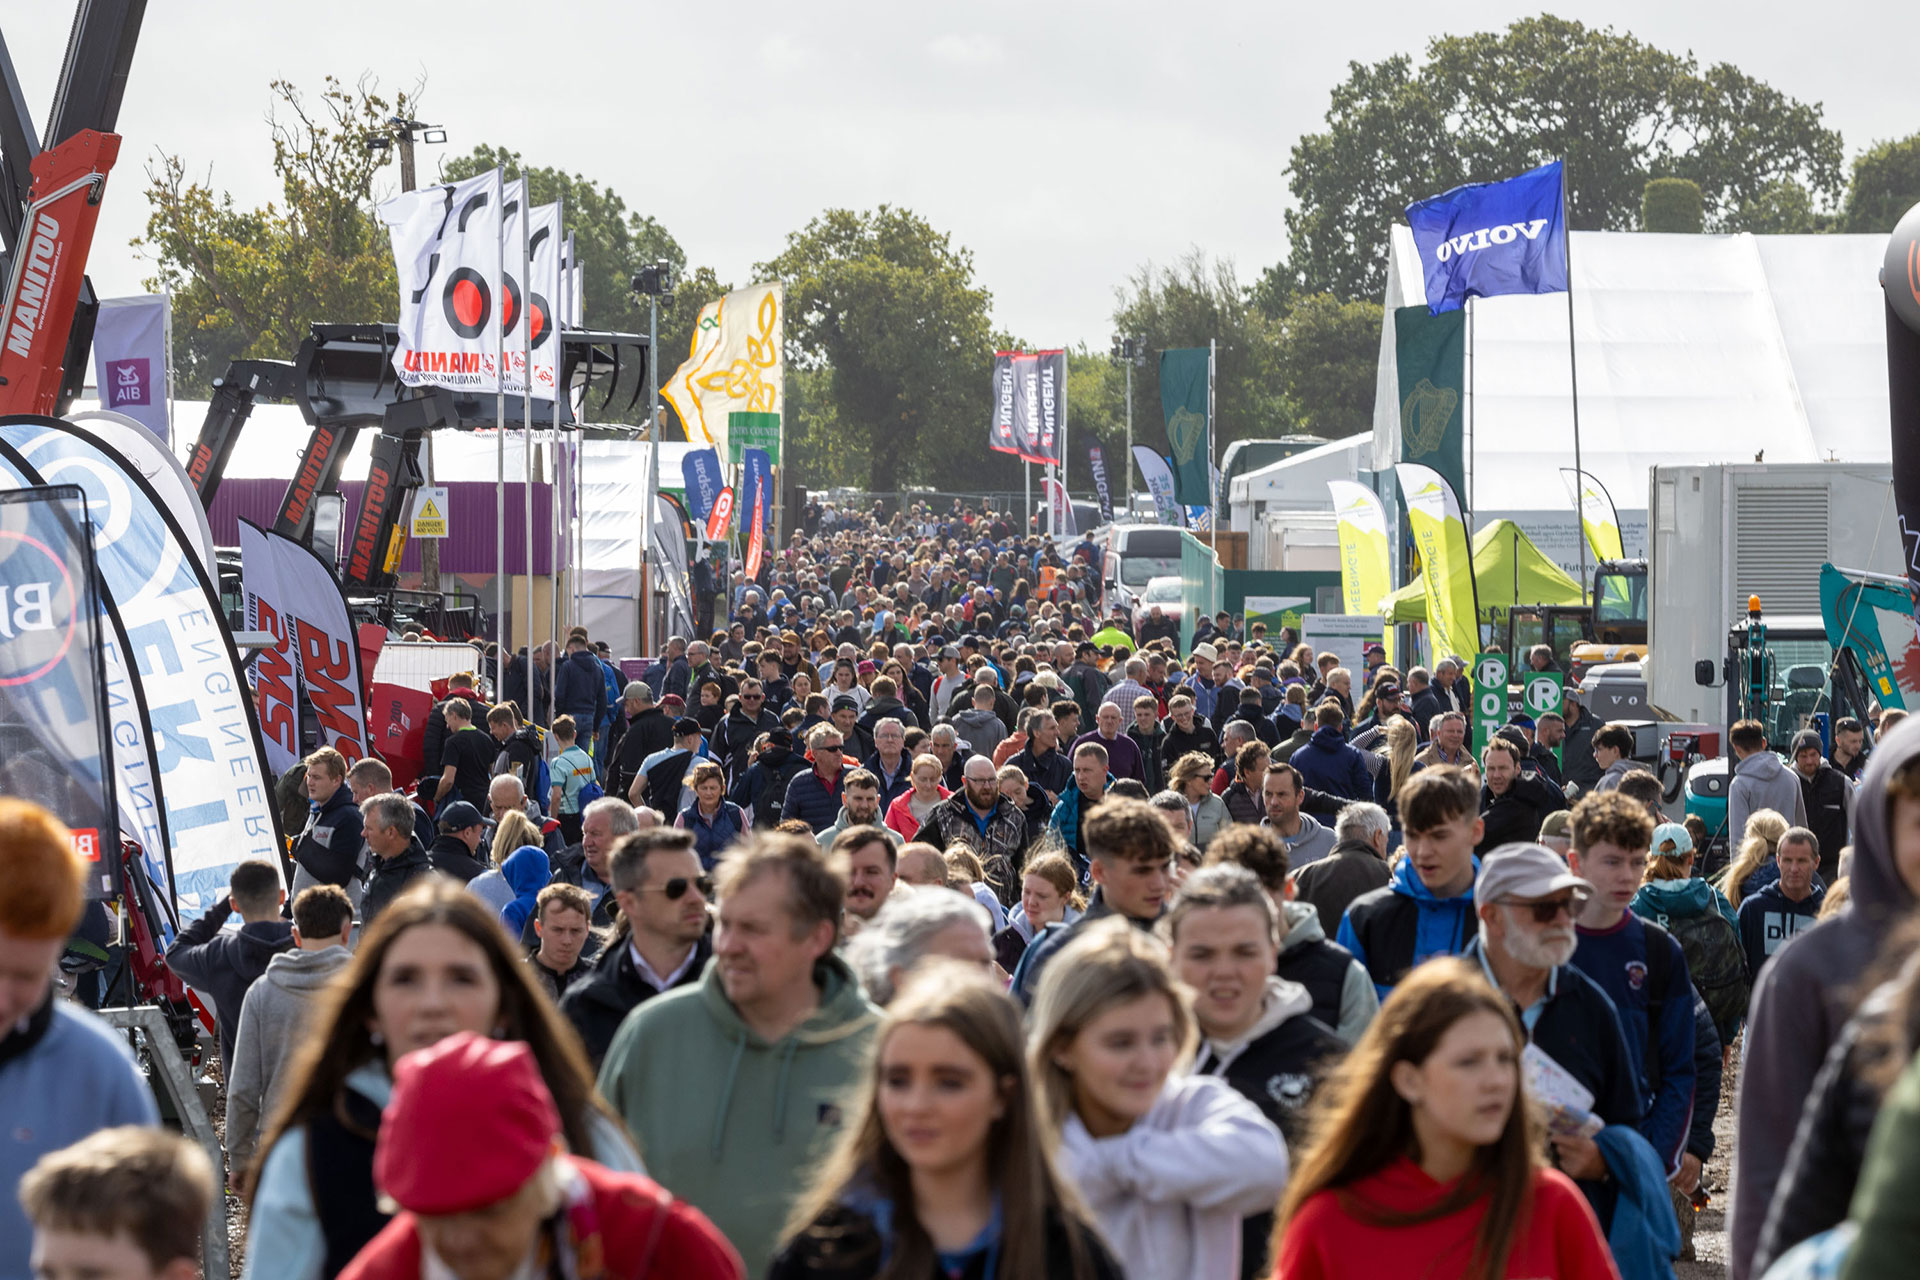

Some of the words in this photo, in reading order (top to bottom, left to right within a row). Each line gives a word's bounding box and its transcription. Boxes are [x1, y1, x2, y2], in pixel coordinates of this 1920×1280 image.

[7, 213, 60, 359] MANITOU
[116, 386, 141, 402] AIB
[285, 427, 334, 525] MANITOU
[350, 466, 390, 583] MANITOU
[1563, 562, 1595, 573] Futre
[248, 591, 257, 628] BAILEY
[256, 596, 296, 756] BMS
[390, 700, 403, 723] 200
